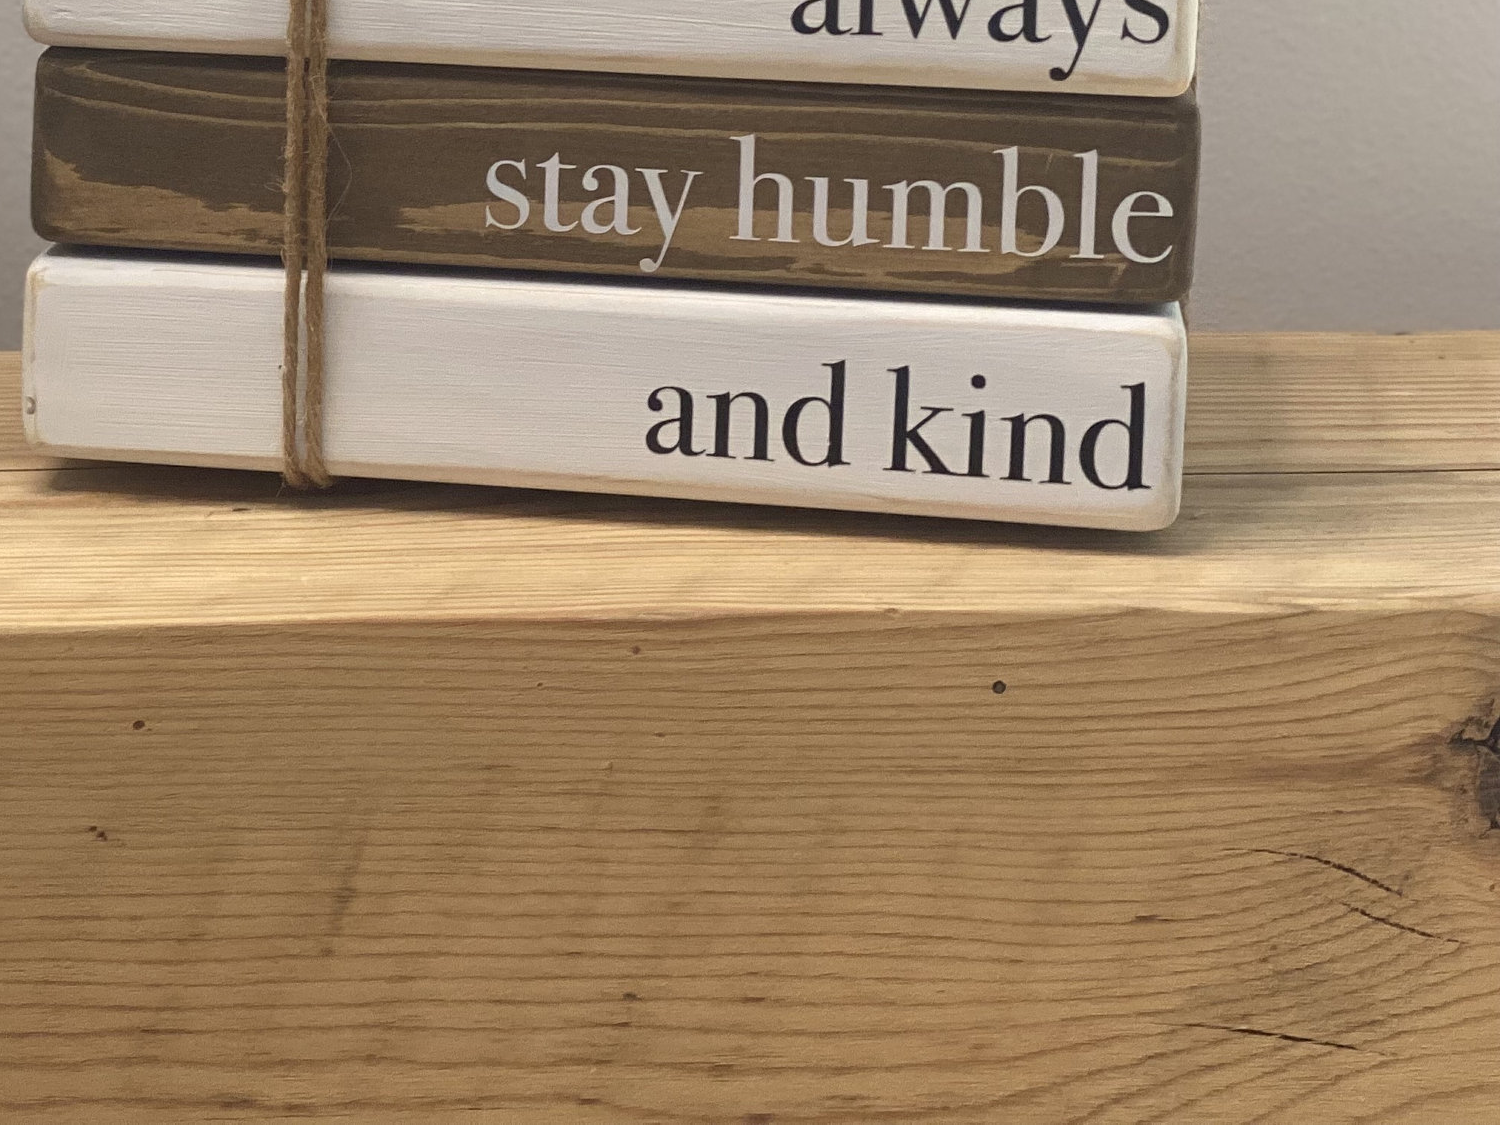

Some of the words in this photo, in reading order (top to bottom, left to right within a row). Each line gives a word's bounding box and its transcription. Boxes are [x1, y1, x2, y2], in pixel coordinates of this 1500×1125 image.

[484, 151, 703, 273] stay
[729, 134, 1175, 263] humble
[645, 360, 851, 468] and
[883, 366, 1152, 491] kind
